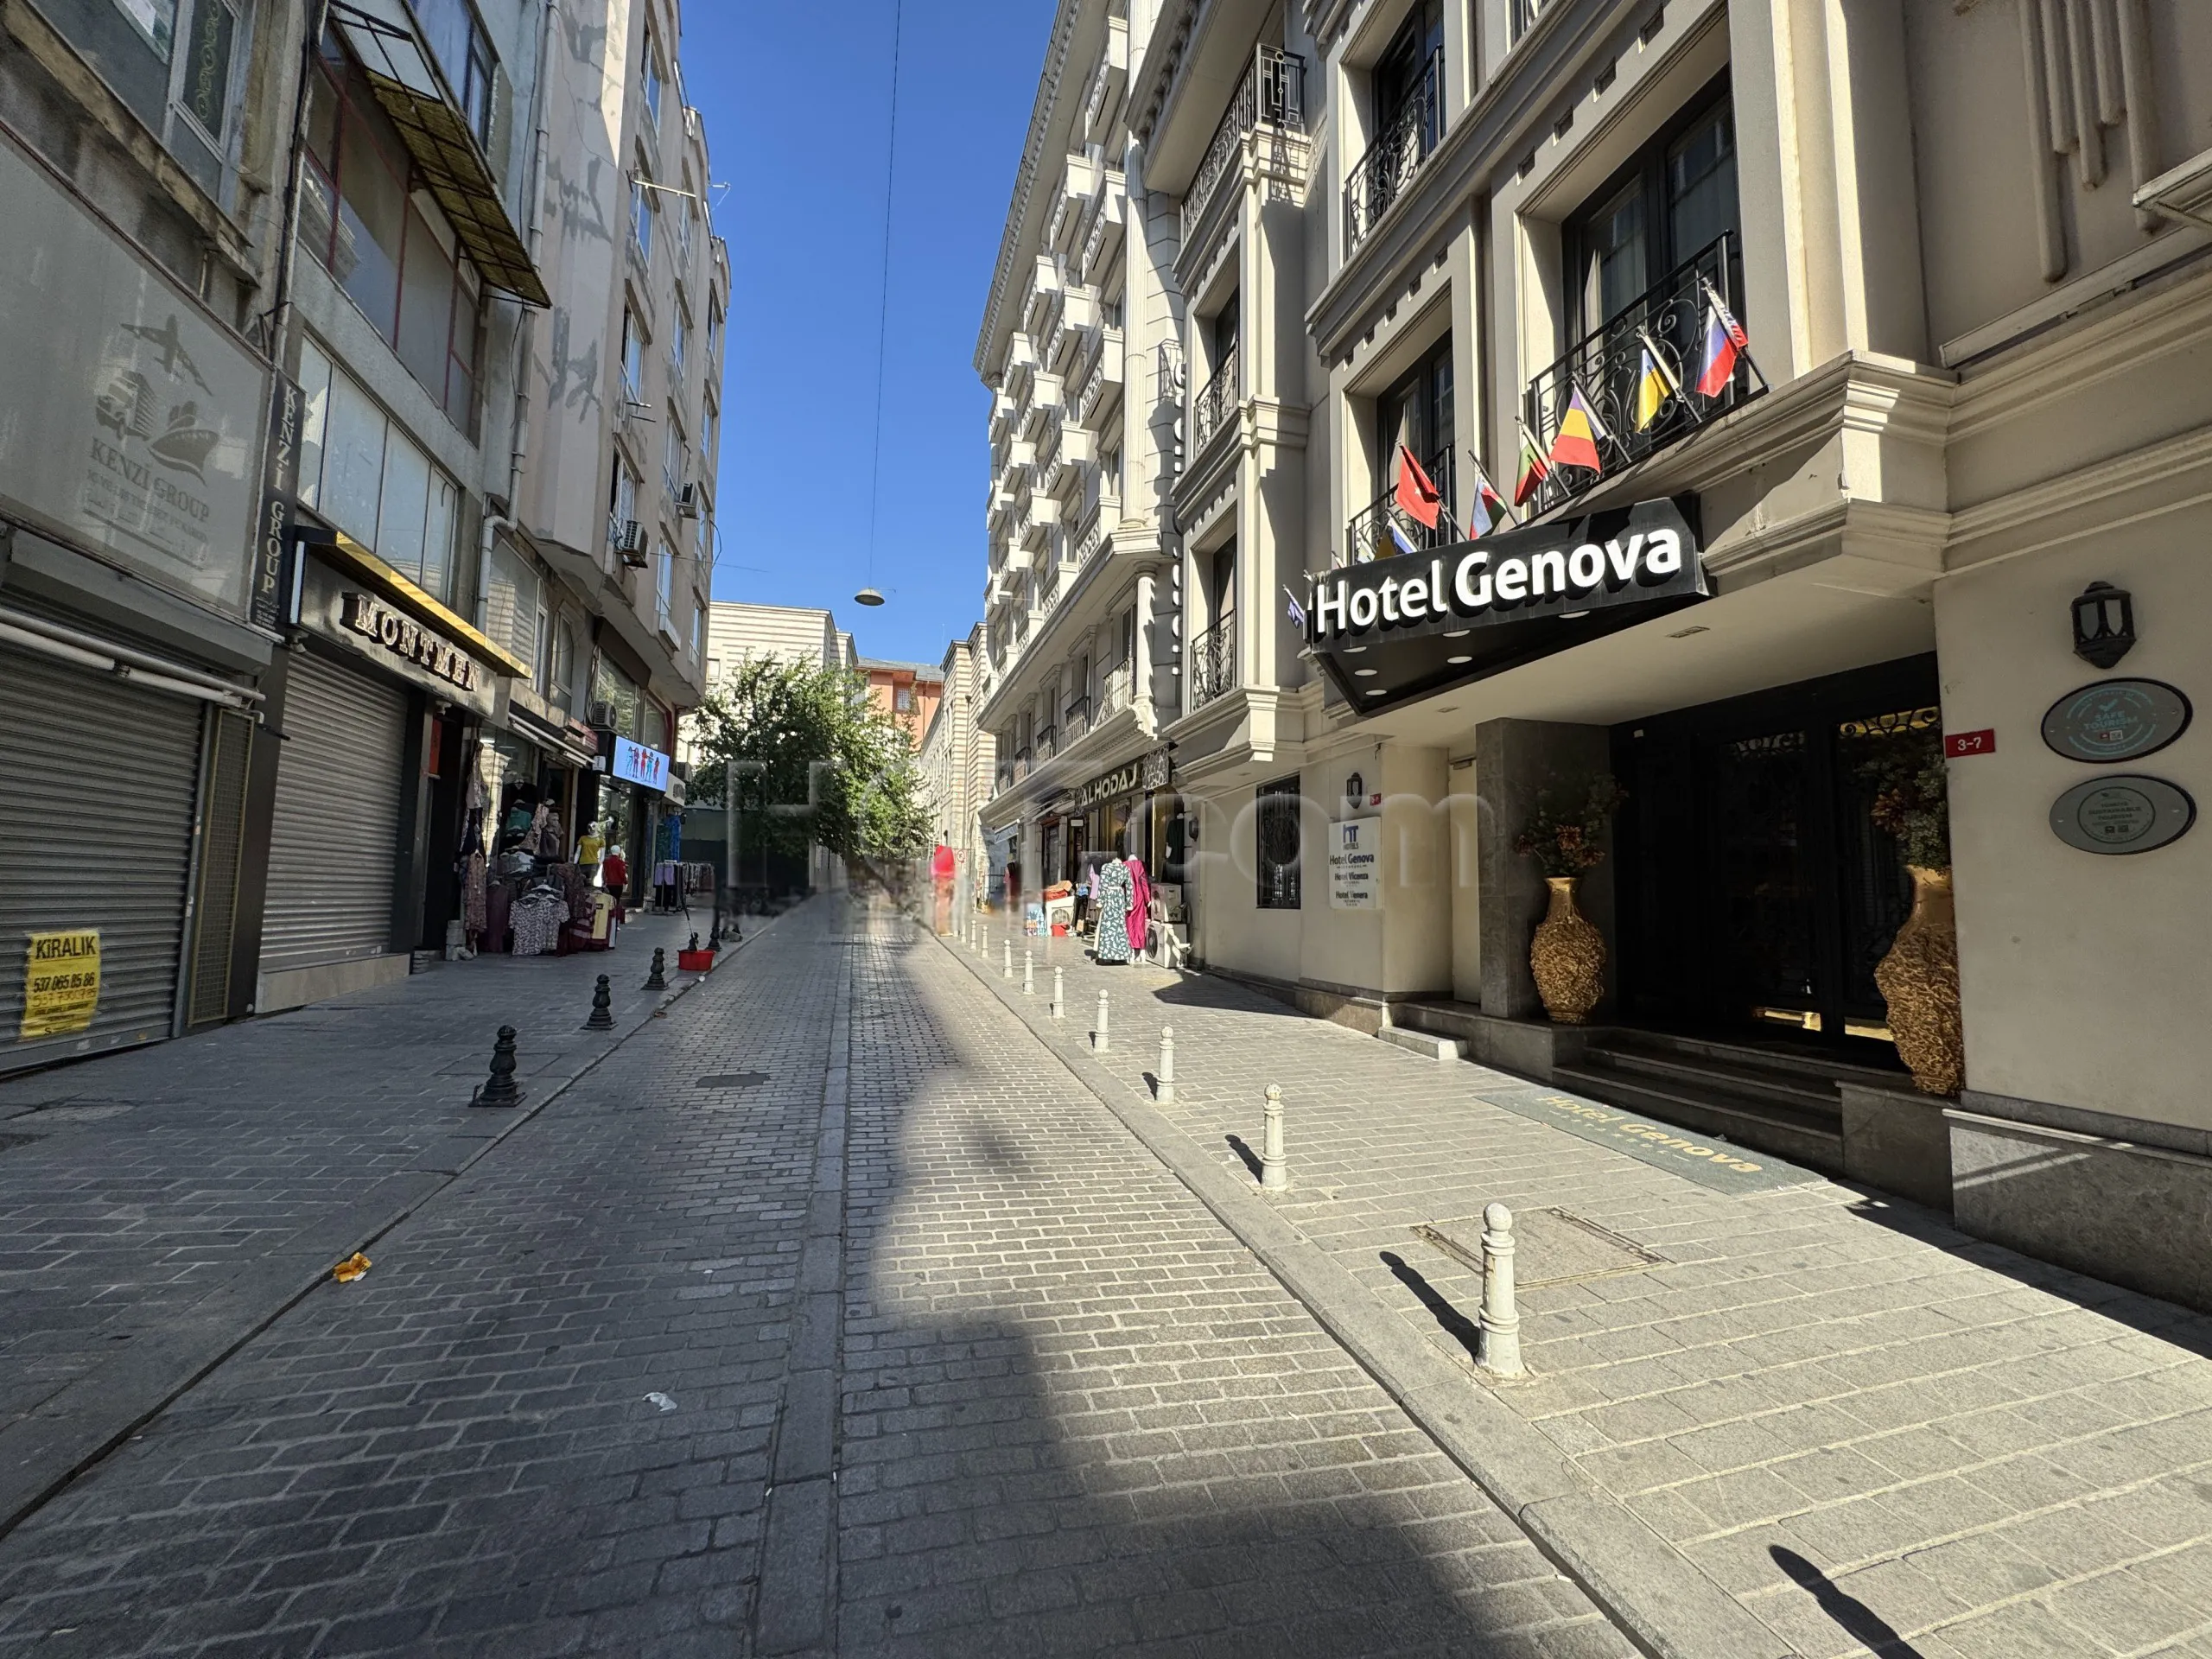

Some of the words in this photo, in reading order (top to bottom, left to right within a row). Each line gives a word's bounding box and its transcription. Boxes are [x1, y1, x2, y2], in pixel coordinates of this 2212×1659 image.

[152, 476, 210, 522] GROUP
[261, 500, 284, 594] GROUP
[1317, 559, 1447, 632] Hotel
[1454, 528, 1681, 607] Genova
[2084, 716, 2139, 731] TOURISM
[2094, 710, 2126, 722] SAFE
[1956, 736, 1983, 752] 3-7
[1081, 762, 1138, 806] ALHODAJ
[1330, 855, 1348, 866] Hotel
[1348, 853, 1375, 864] Genova
[1334, 873, 1348, 881] Hotel
[1349, 872, 1369, 880] Vicenza
[1336, 891, 1349, 899] Hotel
[1350, 891, 1369, 899] Venera
[34, 977, 52, 994] 537
[1536, 1096, 1626, 1123] Hotel
[1619, 1123, 1764, 1173] Genova
